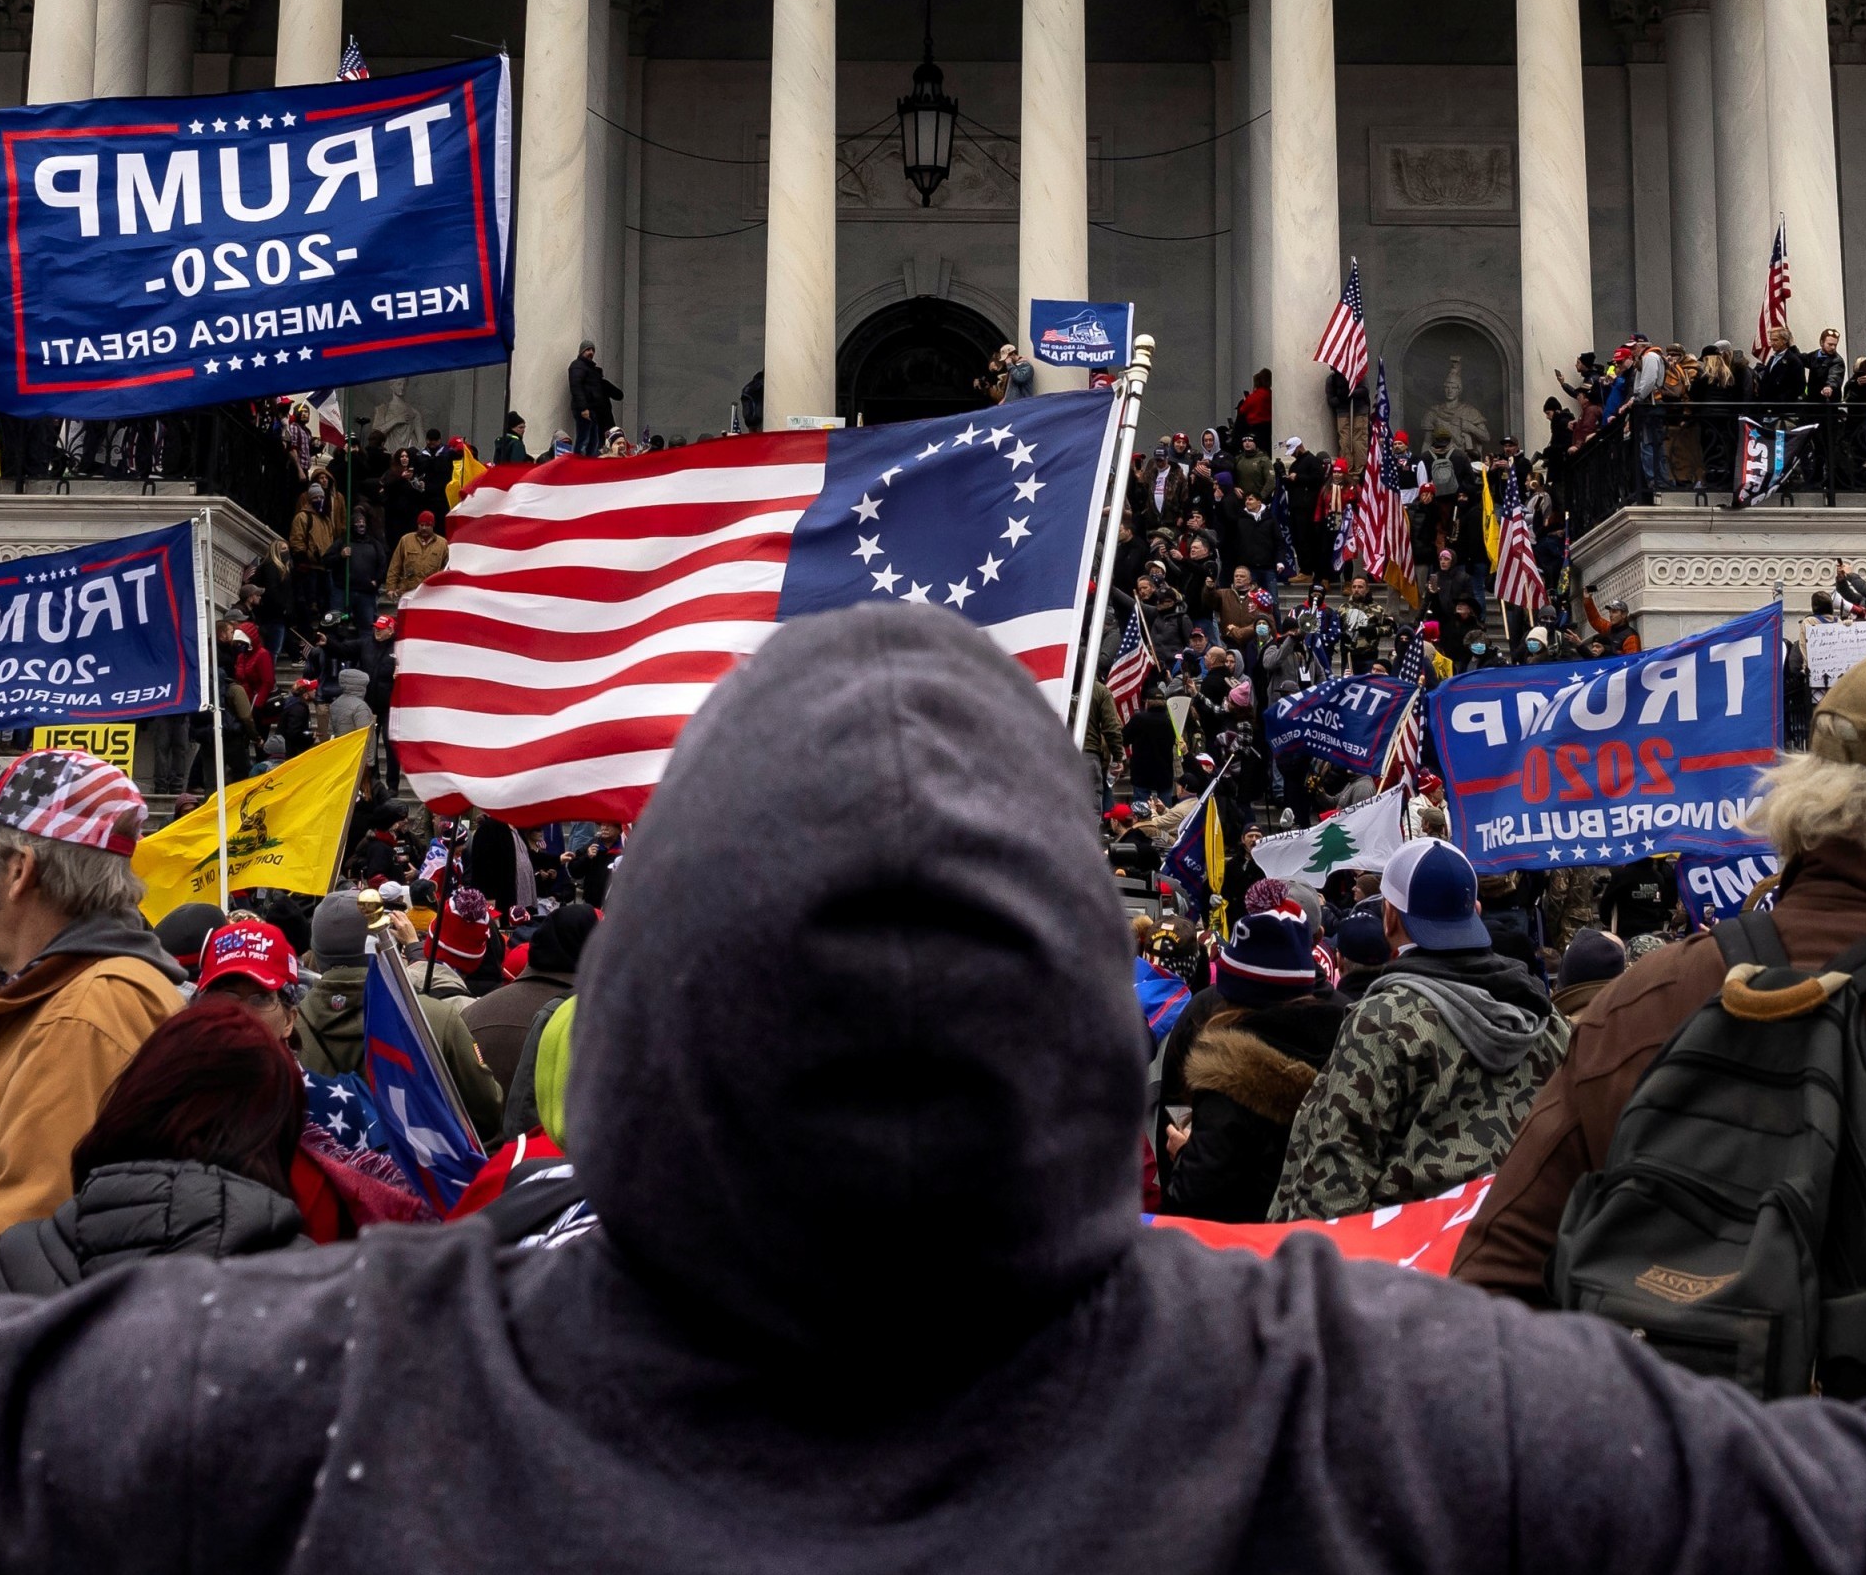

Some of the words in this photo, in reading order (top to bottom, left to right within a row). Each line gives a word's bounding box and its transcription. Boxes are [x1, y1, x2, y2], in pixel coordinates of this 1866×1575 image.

[46, 727, 131, 755] JESUS
[214, 928, 274, 956] TRUMP
[216, 950, 247, 965] AMERICA
[248, 951, 270, 962] FIRST
